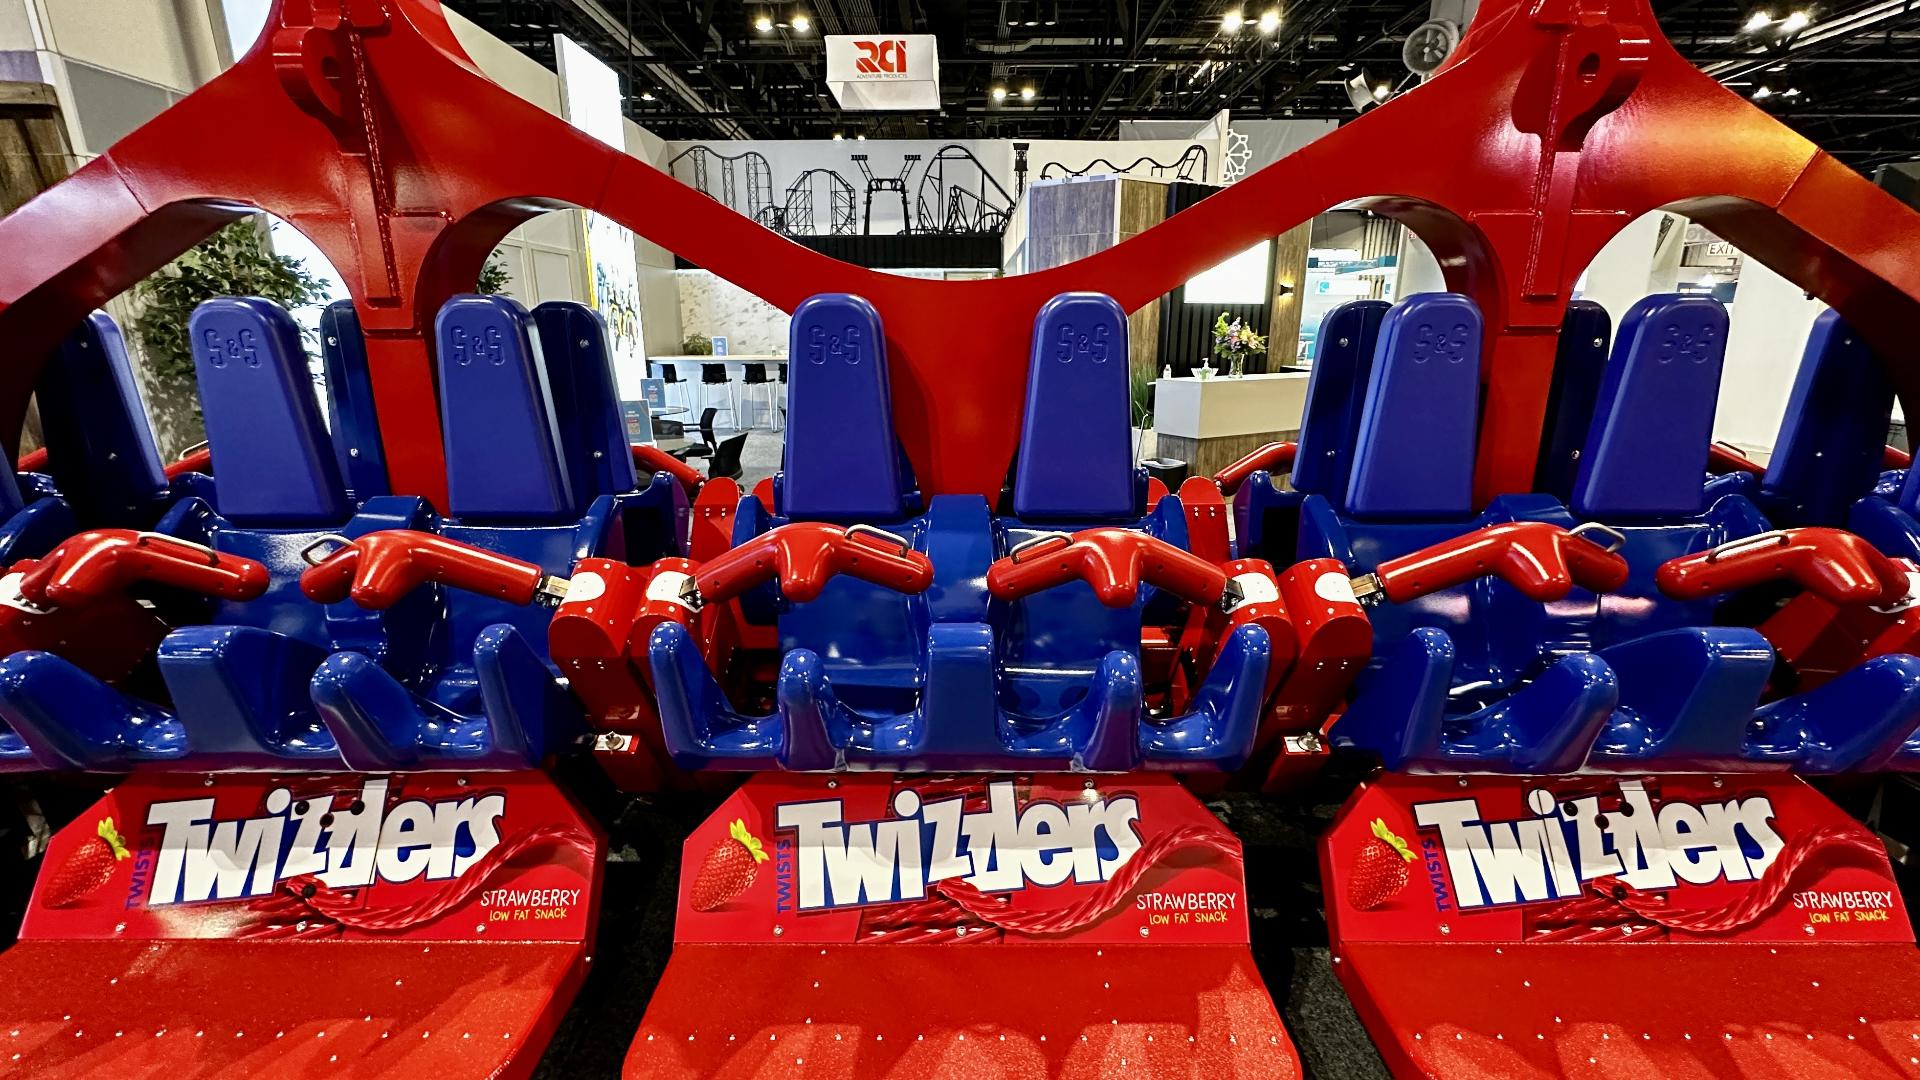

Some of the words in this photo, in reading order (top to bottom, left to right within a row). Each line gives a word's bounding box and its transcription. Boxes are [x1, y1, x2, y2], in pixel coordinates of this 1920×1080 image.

[853, 40, 907, 73] RCI
[204, 328, 262, 369] S&S
[450, 326, 505, 366] S&S
[808, 325, 861, 365] S&S
[1057, 324, 1109, 364] S&S
[147, 779, 504, 905] Twizzlers
[778, 781, 1142, 908] Twizzlers
[1414, 781, 1785, 907] Twizzlers
[776, 838, 792, 913] TWISTS
[1420, 837, 1452, 913] TWISTS
[480, 888, 581, 907] STRAWBERRY
[489, 909, 510, 922] LOW
[513, 909, 530, 920] FAT
[534, 906, 567, 919] SNACK
[1136, 892, 1236, 911] STRAWBERRY
[1148, 913, 1169, 925] LOW
[1174, 912, 1189, 924] FAT
[1195, 910, 1228, 923] SNACK
[1792, 890, 1893, 909] STRAWBERRY
[1808, 912, 1831, 924] LOW
[1833, 911, 1850, 922] FAT
[1854, 909, 1890, 922] SNACK
